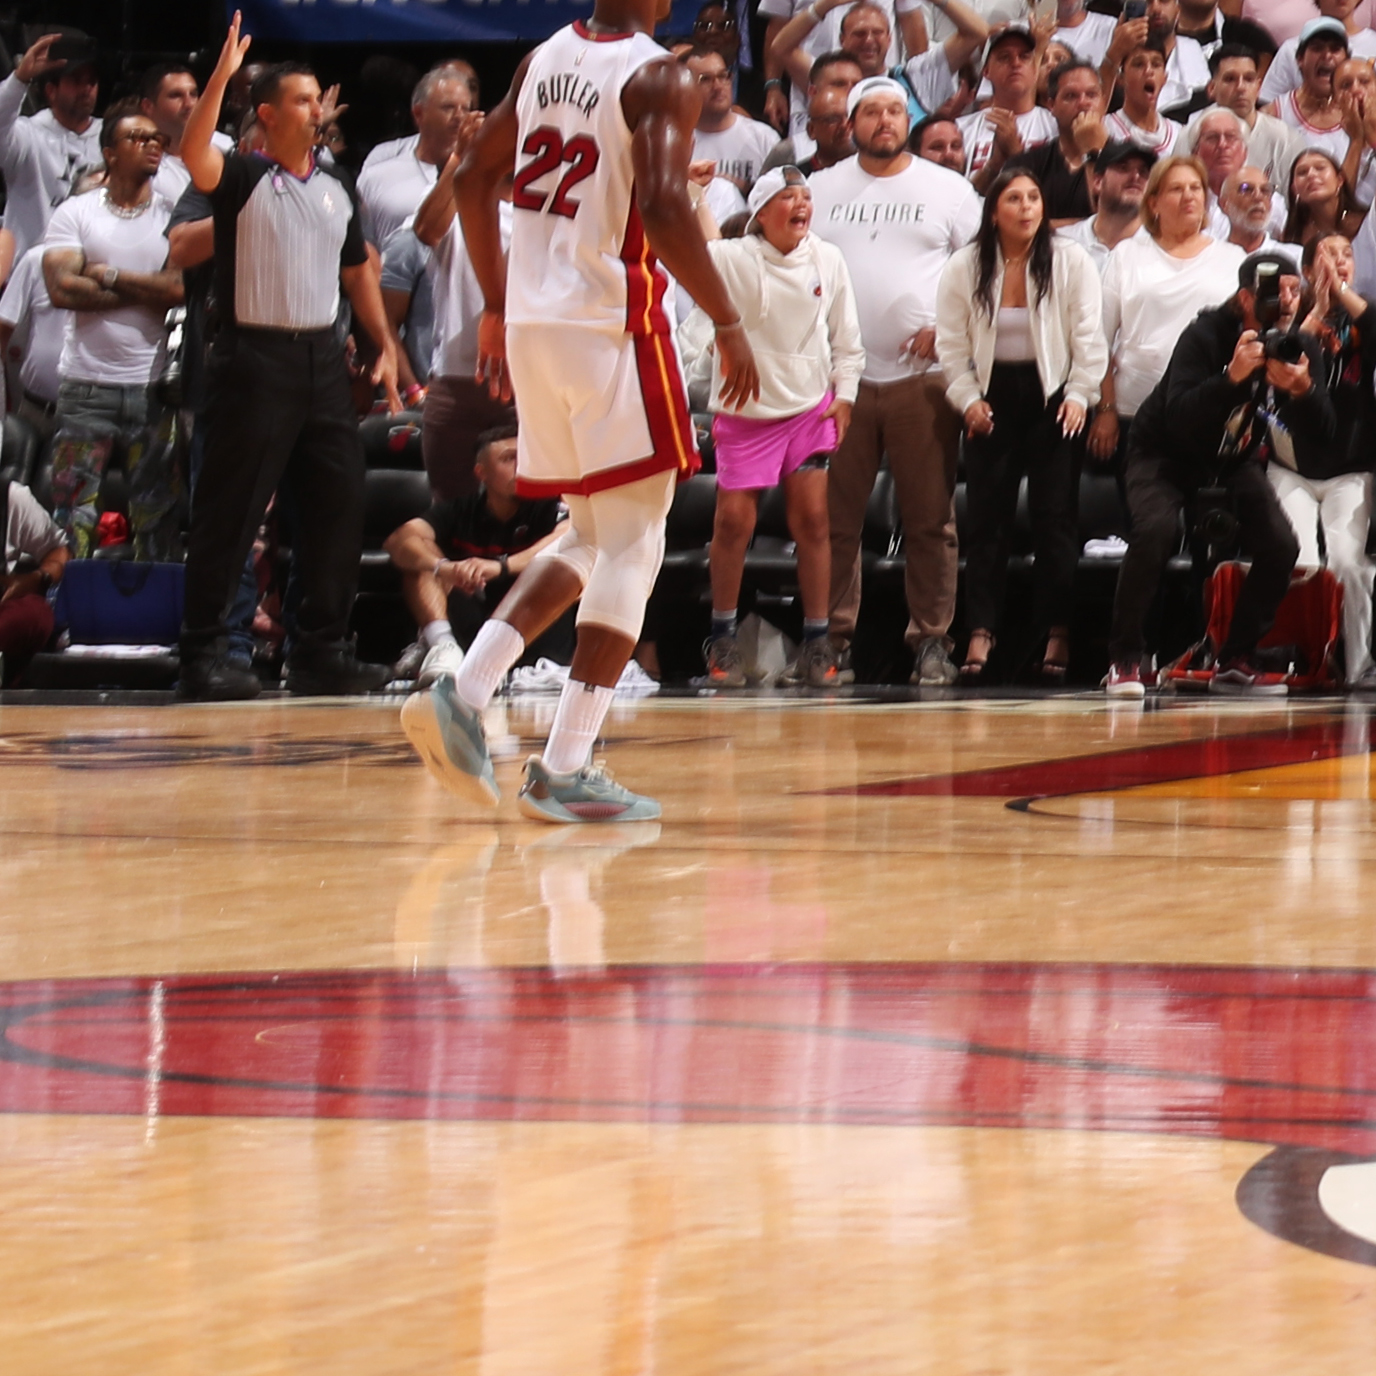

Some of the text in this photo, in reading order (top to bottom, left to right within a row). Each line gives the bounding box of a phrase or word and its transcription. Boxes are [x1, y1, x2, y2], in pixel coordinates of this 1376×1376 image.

[536, 72, 601, 121] BUTLER
[511, 124, 600, 220] 22
[829, 202, 925, 225] CULTURE
